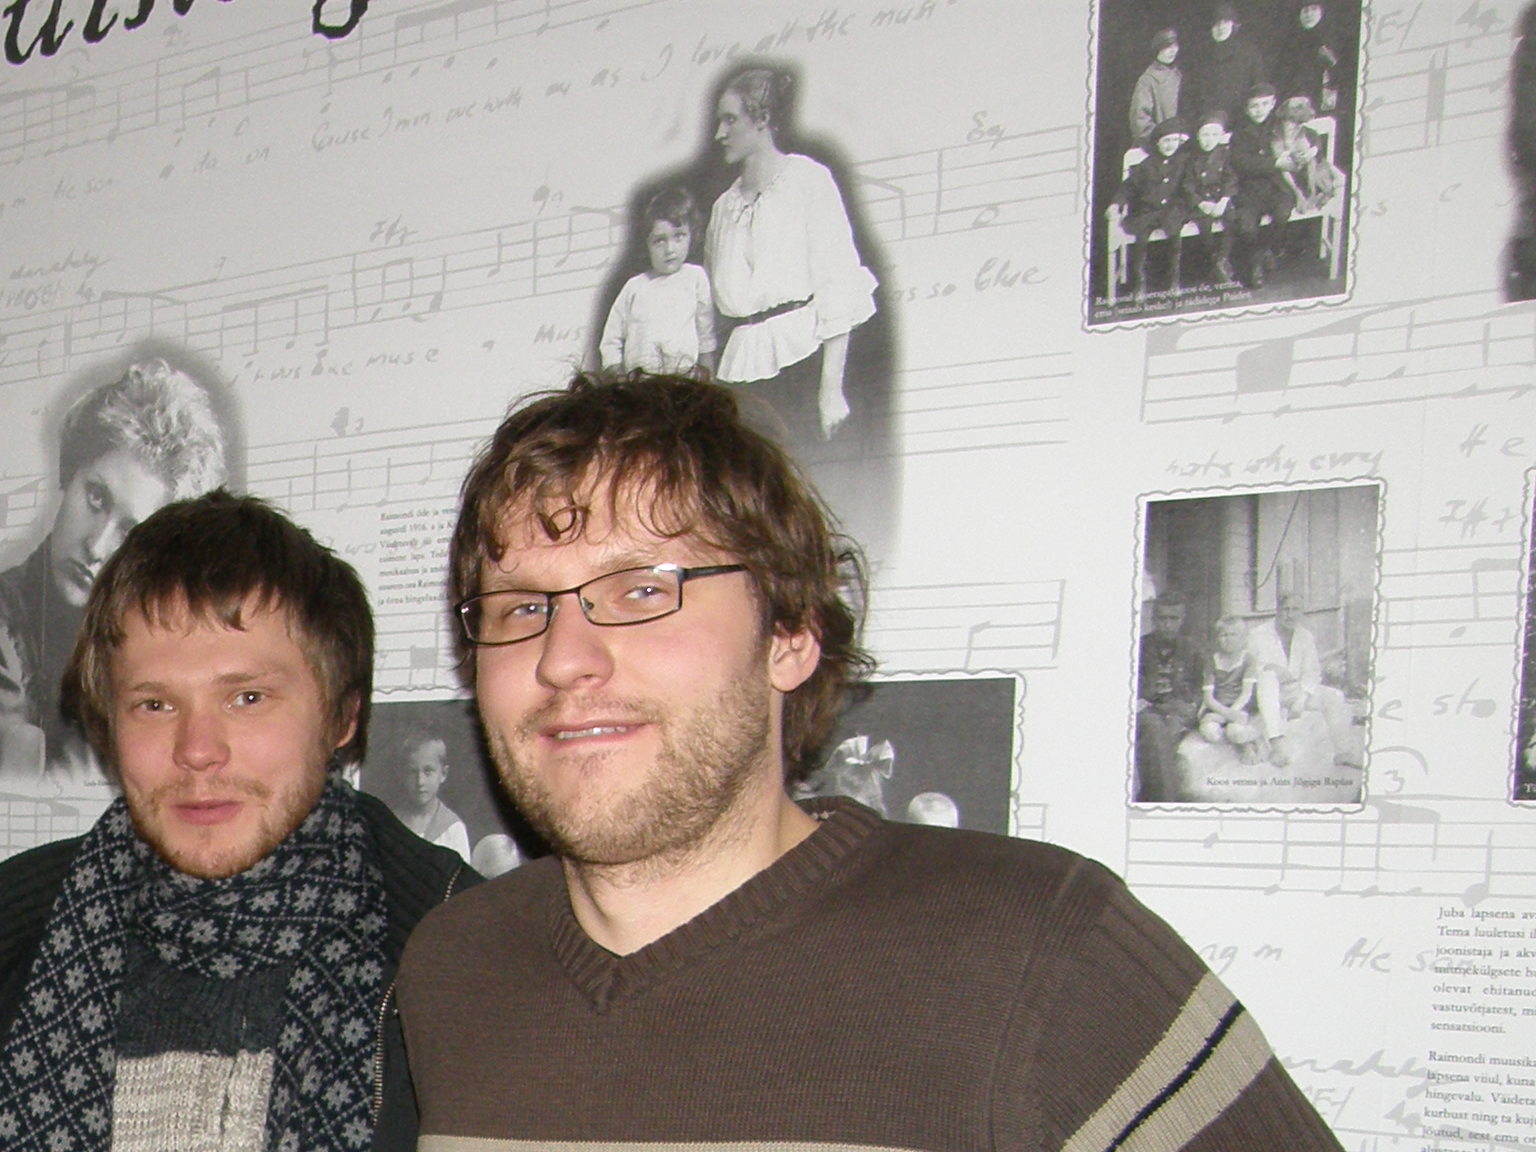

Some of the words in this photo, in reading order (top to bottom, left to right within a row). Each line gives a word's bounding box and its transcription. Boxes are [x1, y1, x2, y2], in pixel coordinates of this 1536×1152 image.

[1437, 907, 1464, 920] Juba
[1471, 908, 1515, 922] lapsena
[1437, 925, 1469, 937] Tema
[1435, 946, 1492, 959] joonistaja
[1500, 948, 1509, 960] ja
[1433, 982, 1472, 993] olevat
[1428, 1050, 1485, 1064] Raimondi
[1427, 1069, 1470, 1084] lapsena
[1425, 1088, 1484, 1103] hingevalu.
[1424, 1106, 1469, 1122] kurbust
[1472, 1110, 1498, 1126] ning
[1501, 1113, 1512, 1124] ta
[1468, 1130, 1491, 1141] sest
[1494, 1133, 1519, 1143] ema
